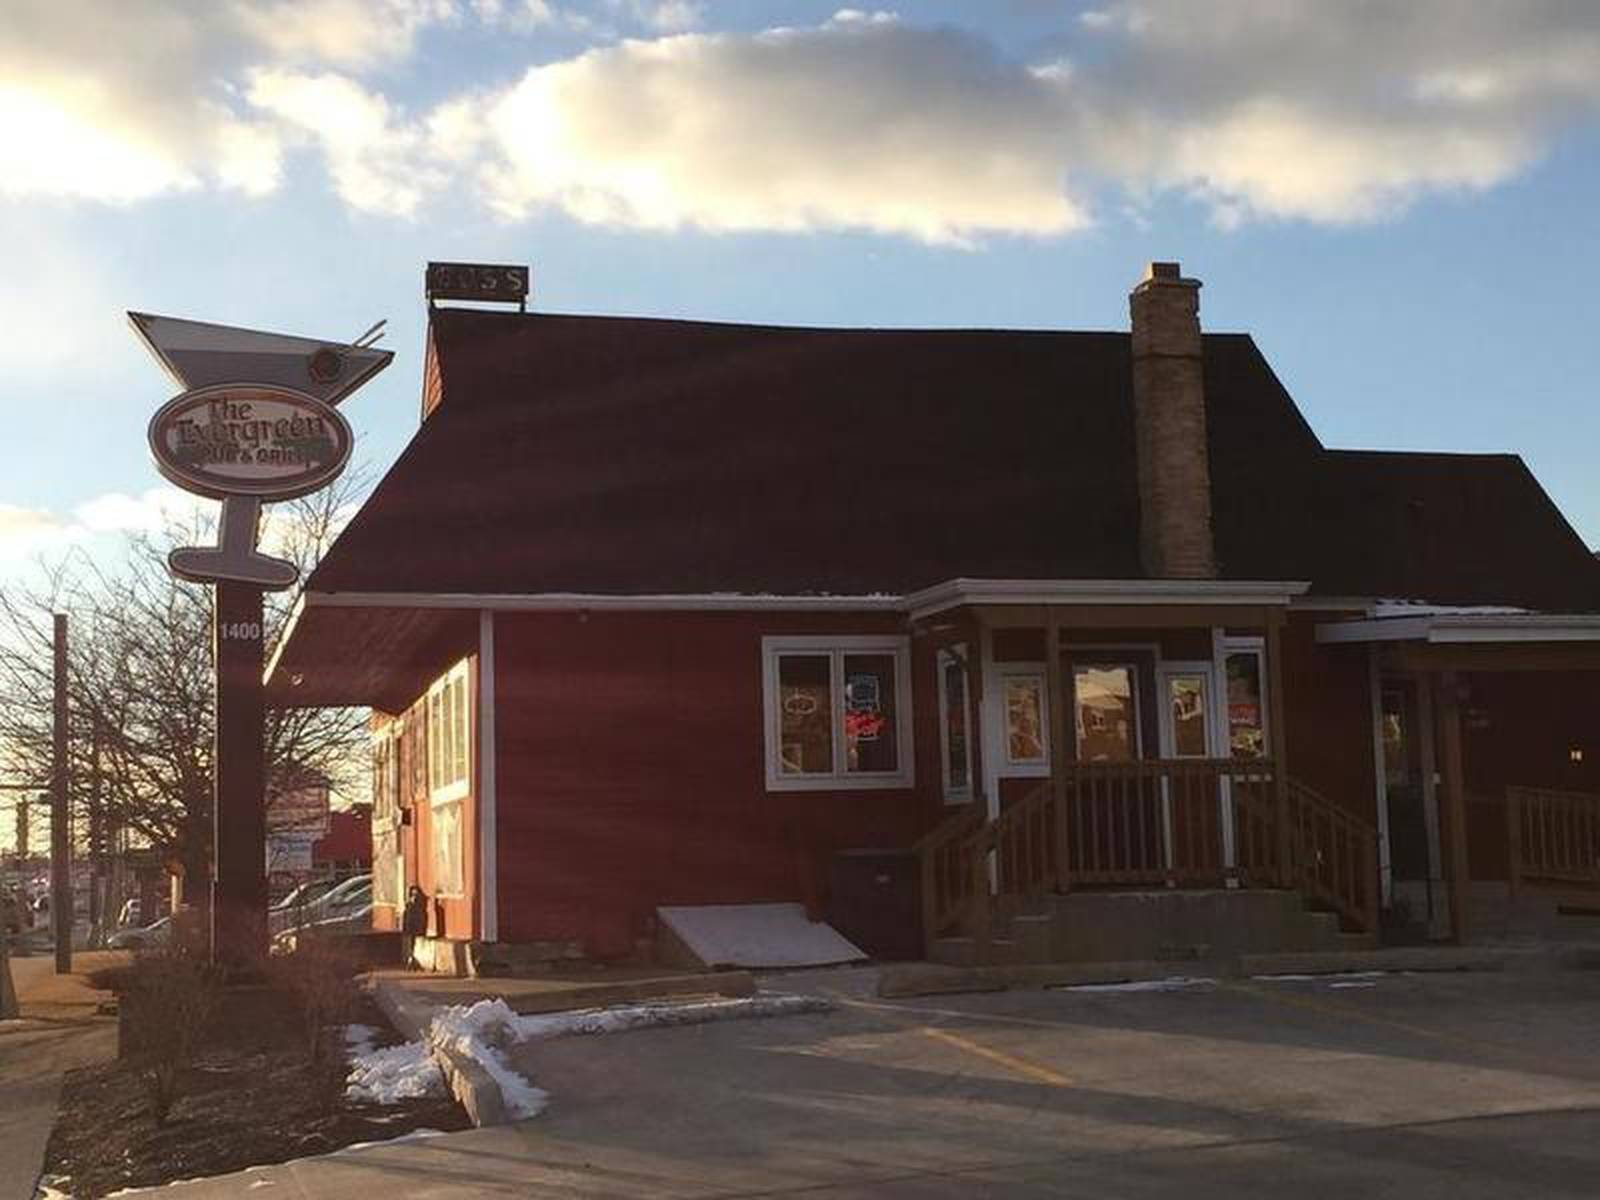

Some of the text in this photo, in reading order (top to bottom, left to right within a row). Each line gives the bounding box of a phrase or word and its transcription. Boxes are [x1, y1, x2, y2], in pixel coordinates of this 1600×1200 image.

[208, 397, 252, 421] The
[178, 413, 323, 448] Evergreen
[220, 622, 260, 640] 1400
